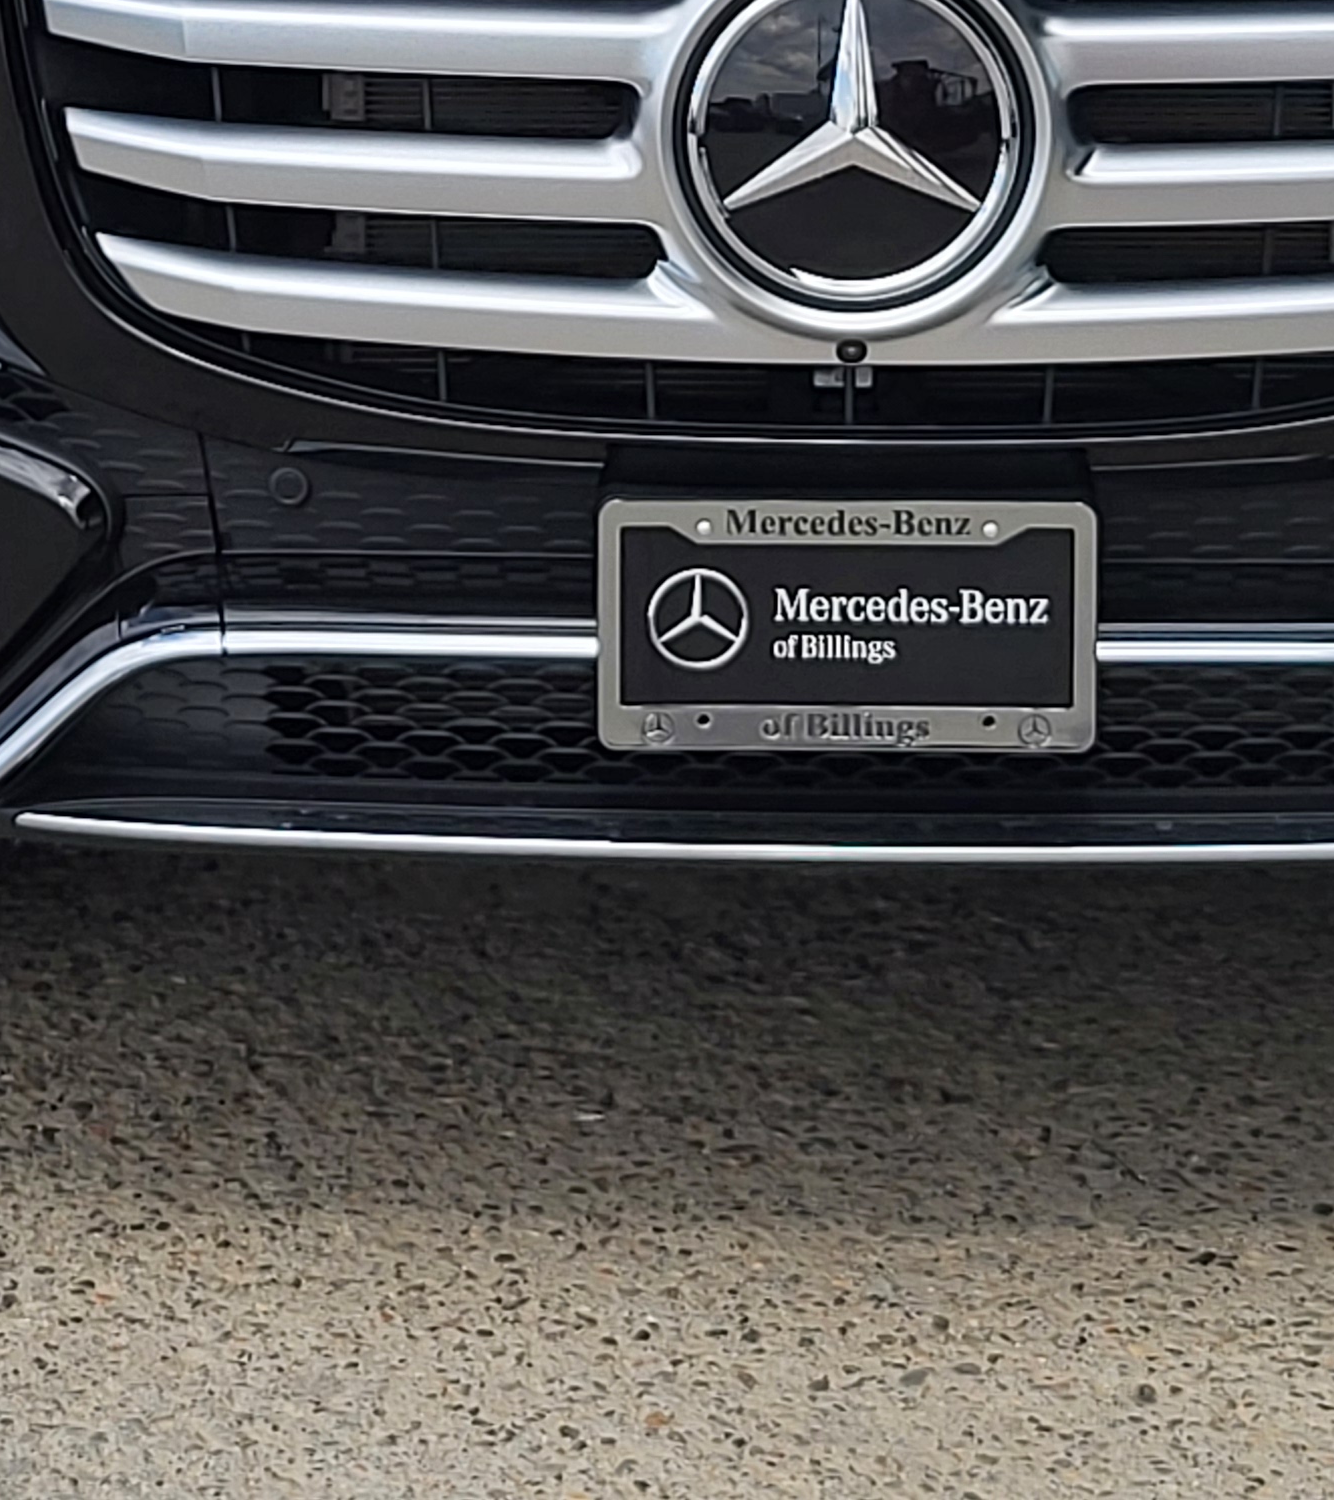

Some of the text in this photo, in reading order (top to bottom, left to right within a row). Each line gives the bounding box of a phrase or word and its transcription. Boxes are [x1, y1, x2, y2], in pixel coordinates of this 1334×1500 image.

[725, 508, 972, 538] Mercedes-Benz
[773, 587, 1050, 625] Mercedes-Benz
[772, 634, 897, 665] of Billings
[762, 712, 930, 747] of Billings
